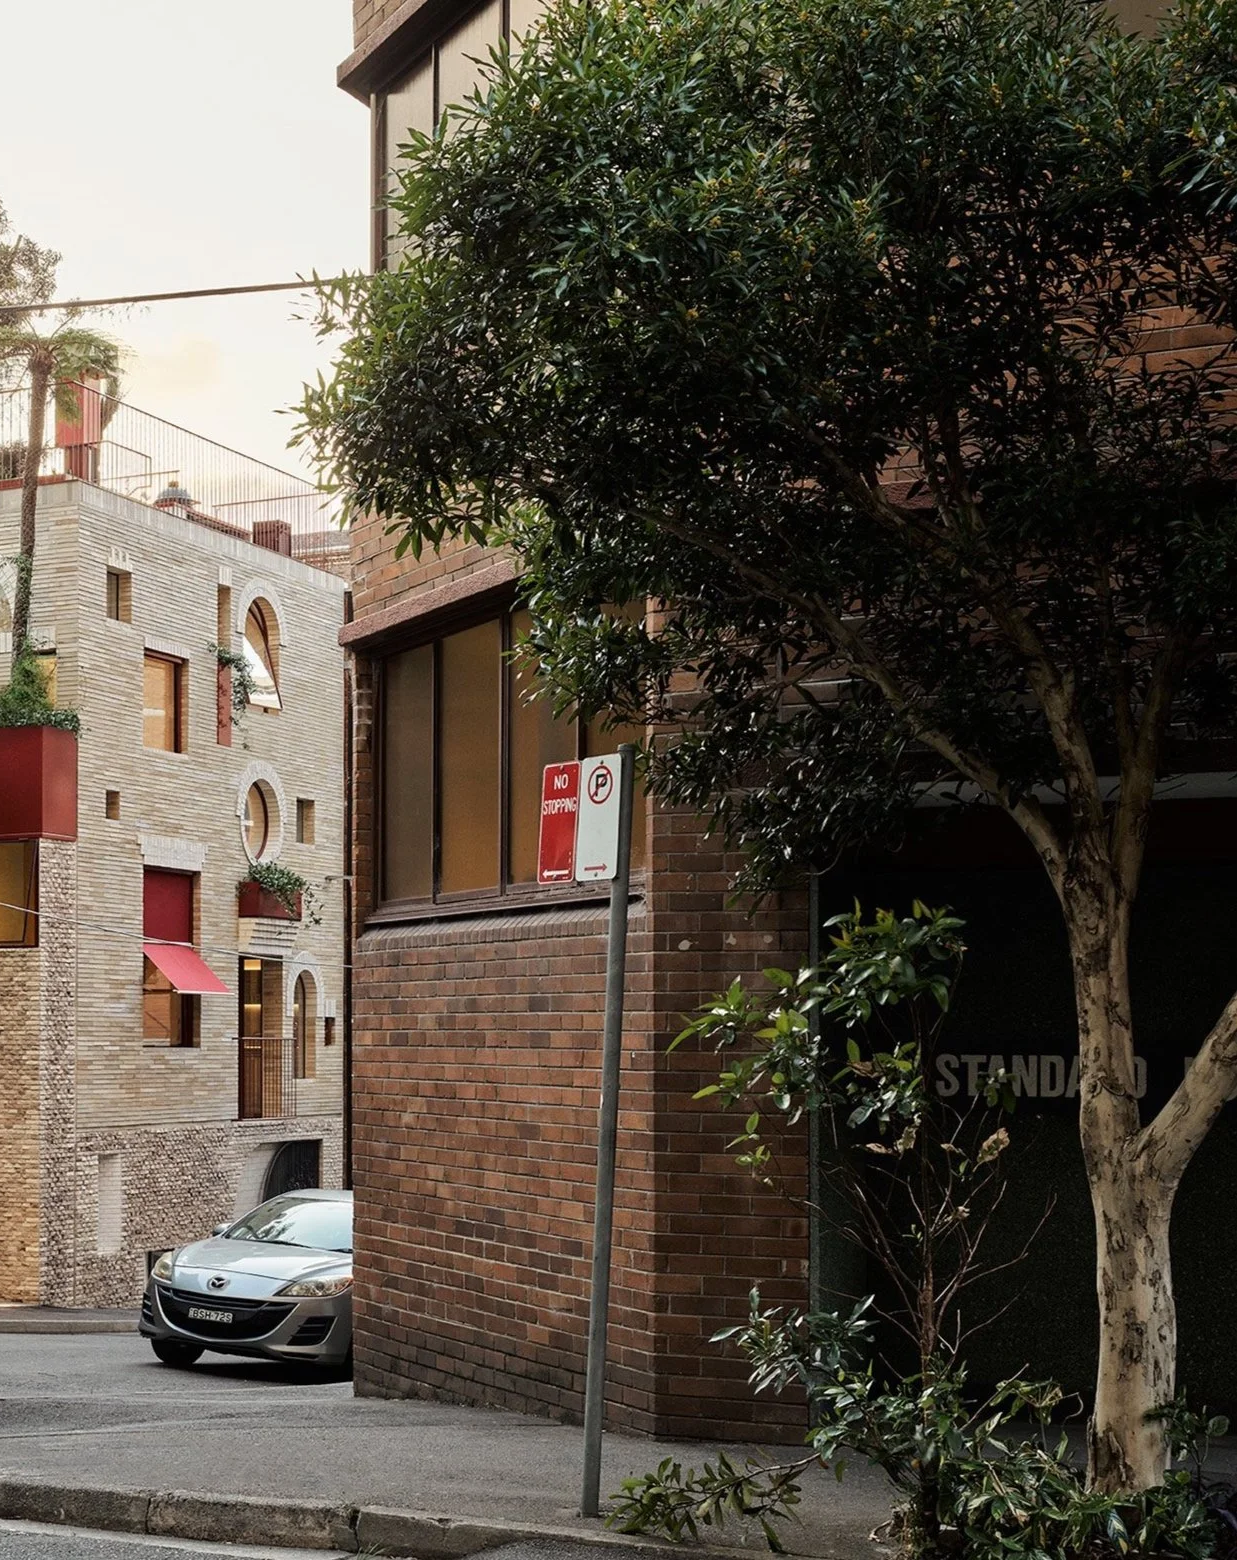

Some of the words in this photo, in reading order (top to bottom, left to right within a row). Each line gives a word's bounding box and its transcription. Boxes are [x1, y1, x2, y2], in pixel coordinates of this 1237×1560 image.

[553, 774, 569, 790] NO
[542, 796, 578, 816] STOPPING
[935, 1053, 1147, 1099] STANDAD
